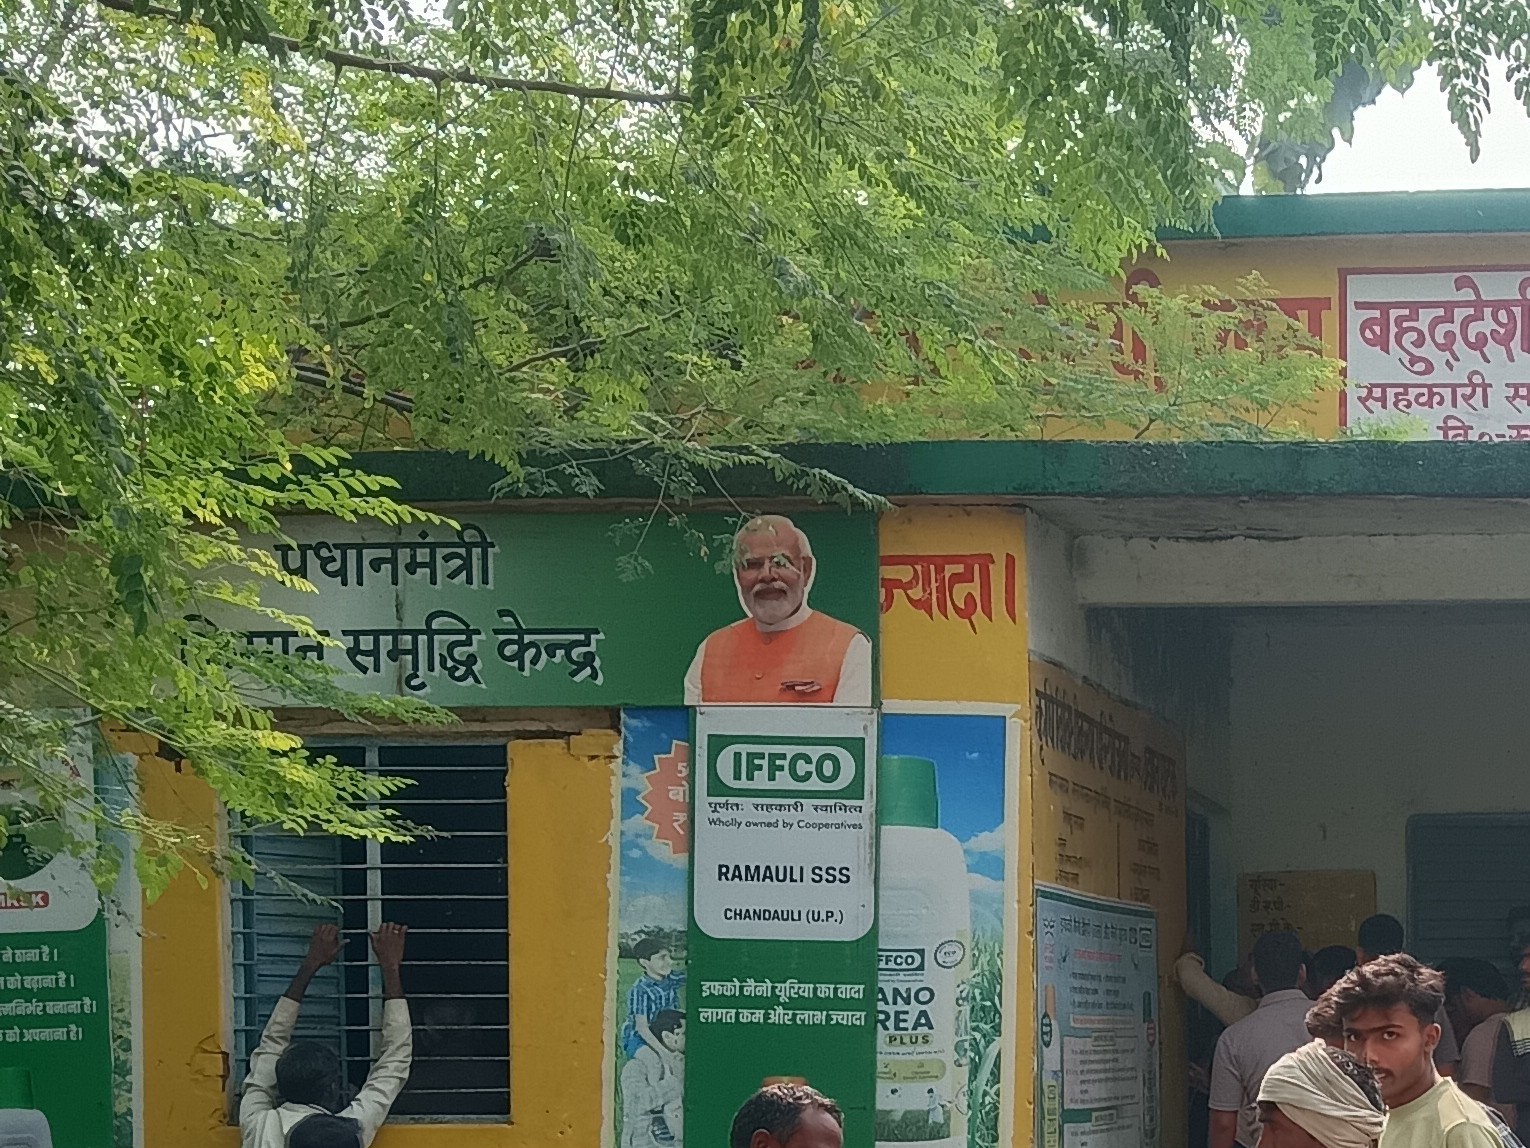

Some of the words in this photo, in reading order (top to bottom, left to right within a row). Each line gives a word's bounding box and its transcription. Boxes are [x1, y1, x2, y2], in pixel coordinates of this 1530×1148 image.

[1356, 370, 1492, 414] सहकारी
[341, 609, 483, 692] समृद्धि
[491, 608, 603, 685] केन्द्र
[732, 751, 842, 784] IFFCO
[752, 801, 804, 814] सहकारी
[812, 802, 863, 815] स्वामित्व
[707, 816, 742, 830] Wholly
[745, 818, 779, 830] owned
[782, 818, 794, 831] by
[797, 819, 863, 831] Cooperatives
[717, 863, 804, 884] RAMAULI
[811, 865, 851, 885] SSS
[723, 907, 801, 922] CHANDAULI
[806, 908, 844, 924] (U.P.)
[878, 954, 916, 966] FFCO
[701, 978, 740, 998] इफको
[742, 979, 772, 998] नैनो
[775, 979, 813, 1003] यूरिया
[816, 981, 836, 999] का
[837, 983, 865, 1000] वादा
[877, 986, 936, 1006] ANO
[699, 1007, 735, 1024] लागत
[738, 1008, 764, 1025] कम
[767, 1005, 792, 1026] और
[795, 1008, 827, 1026] लाभ
[829, 1010, 866, 1027] ज्यादा
[876, 1009, 935, 1032] REA
[888, 1035, 930, 1046] PLUS
